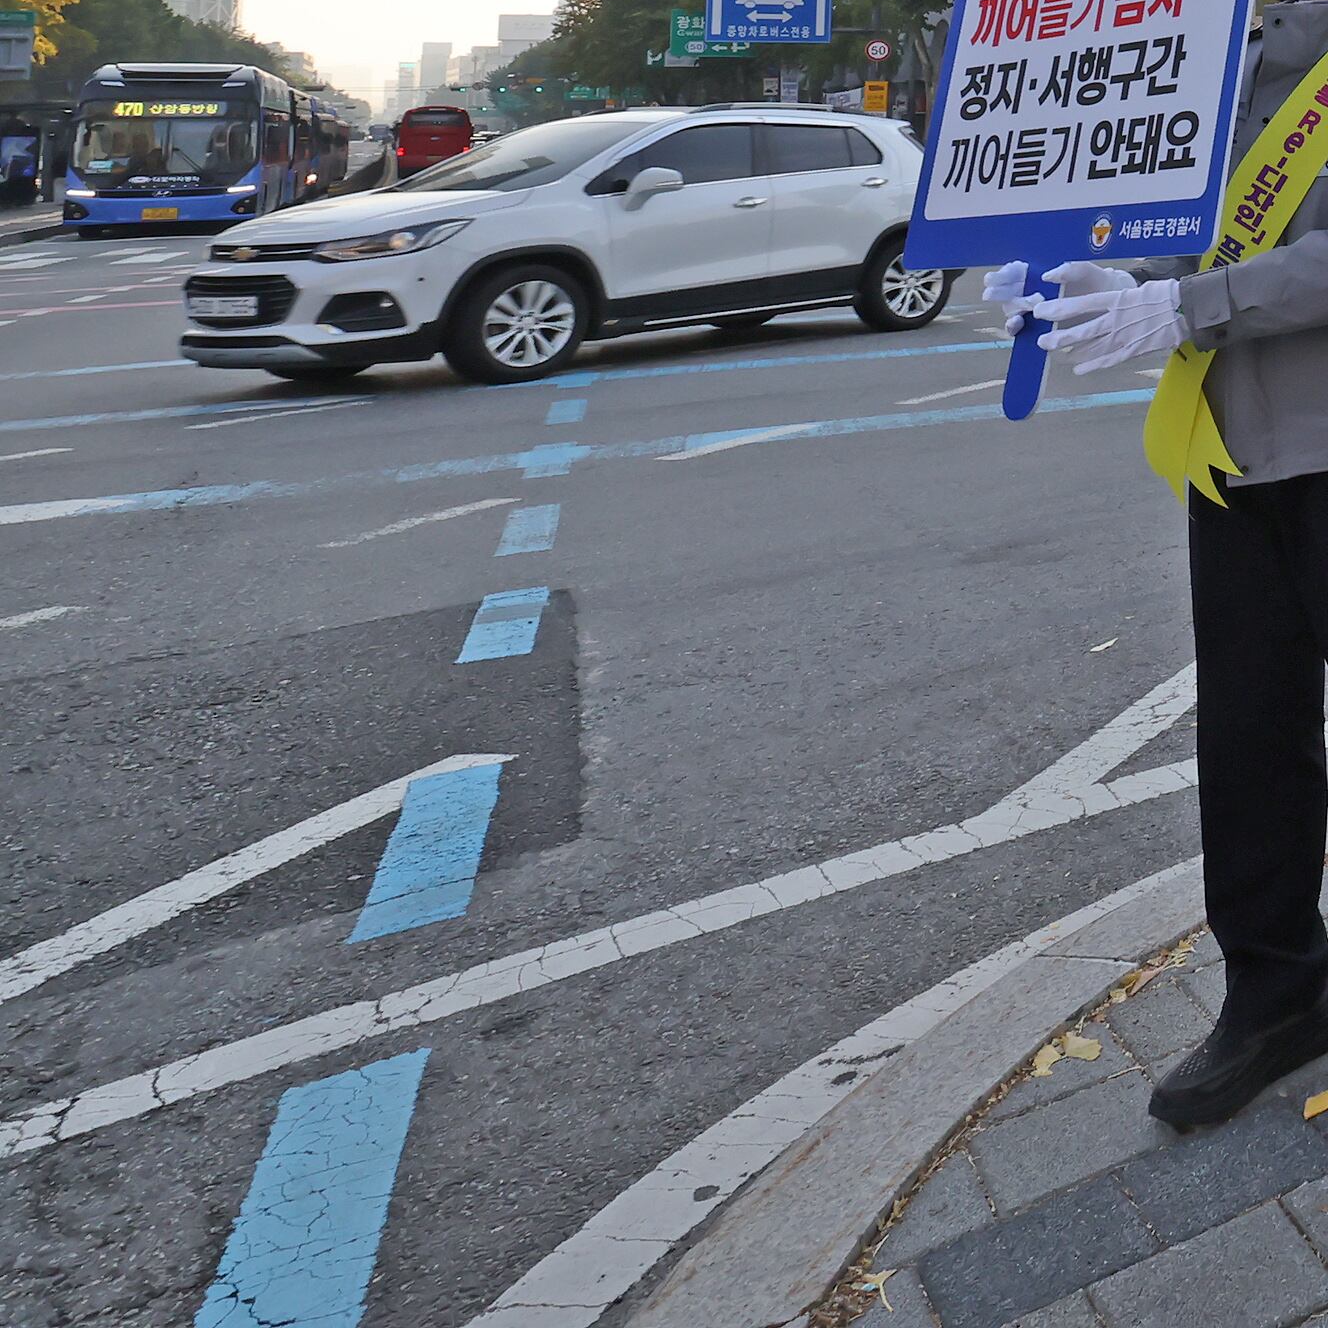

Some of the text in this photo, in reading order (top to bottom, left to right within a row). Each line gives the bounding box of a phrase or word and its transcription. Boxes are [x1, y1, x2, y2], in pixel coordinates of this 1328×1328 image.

[677, 16, 705, 29] 광화
[726, 25, 810, 39] 중앙차로버스전용
[871, 45, 886, 56] 50
[959, 35, 1187, 120] 정지·서행구간
[113, 102, 144, 117] 470
[942, 111, 1200, 192] 끼어들기 안돼요
[1119, 216, 1201, 240] 서울종로경찰서
